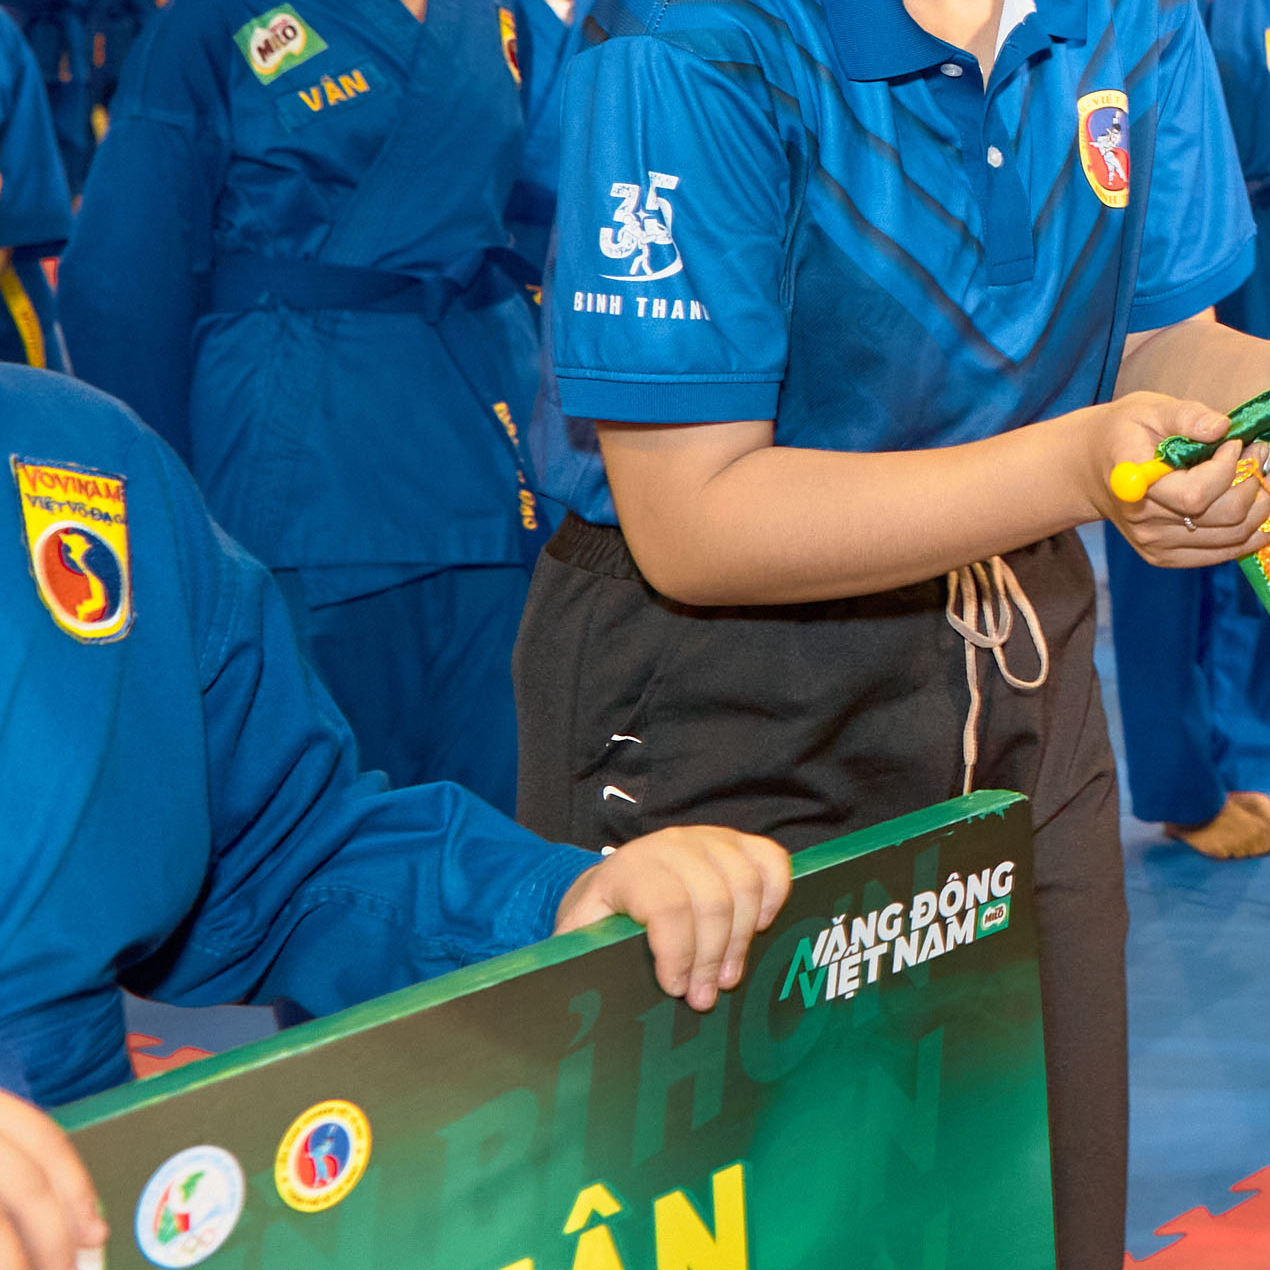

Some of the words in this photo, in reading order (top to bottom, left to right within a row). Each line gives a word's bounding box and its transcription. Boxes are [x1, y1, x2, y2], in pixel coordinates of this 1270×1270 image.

[257, 25, 297, 62] MILO
[573, 291, 622, 316] BINH
[22, 466, 121, 501] VOVINAM
[781, 902, 904, 992] NĂNG
[909, 860, 1016, 930] ĐỘNG
[799, 942, 888, 1009] VIỆT
[892, 908, 976, 974] NAM
[503, 1162, 745, 1270] ÂN
